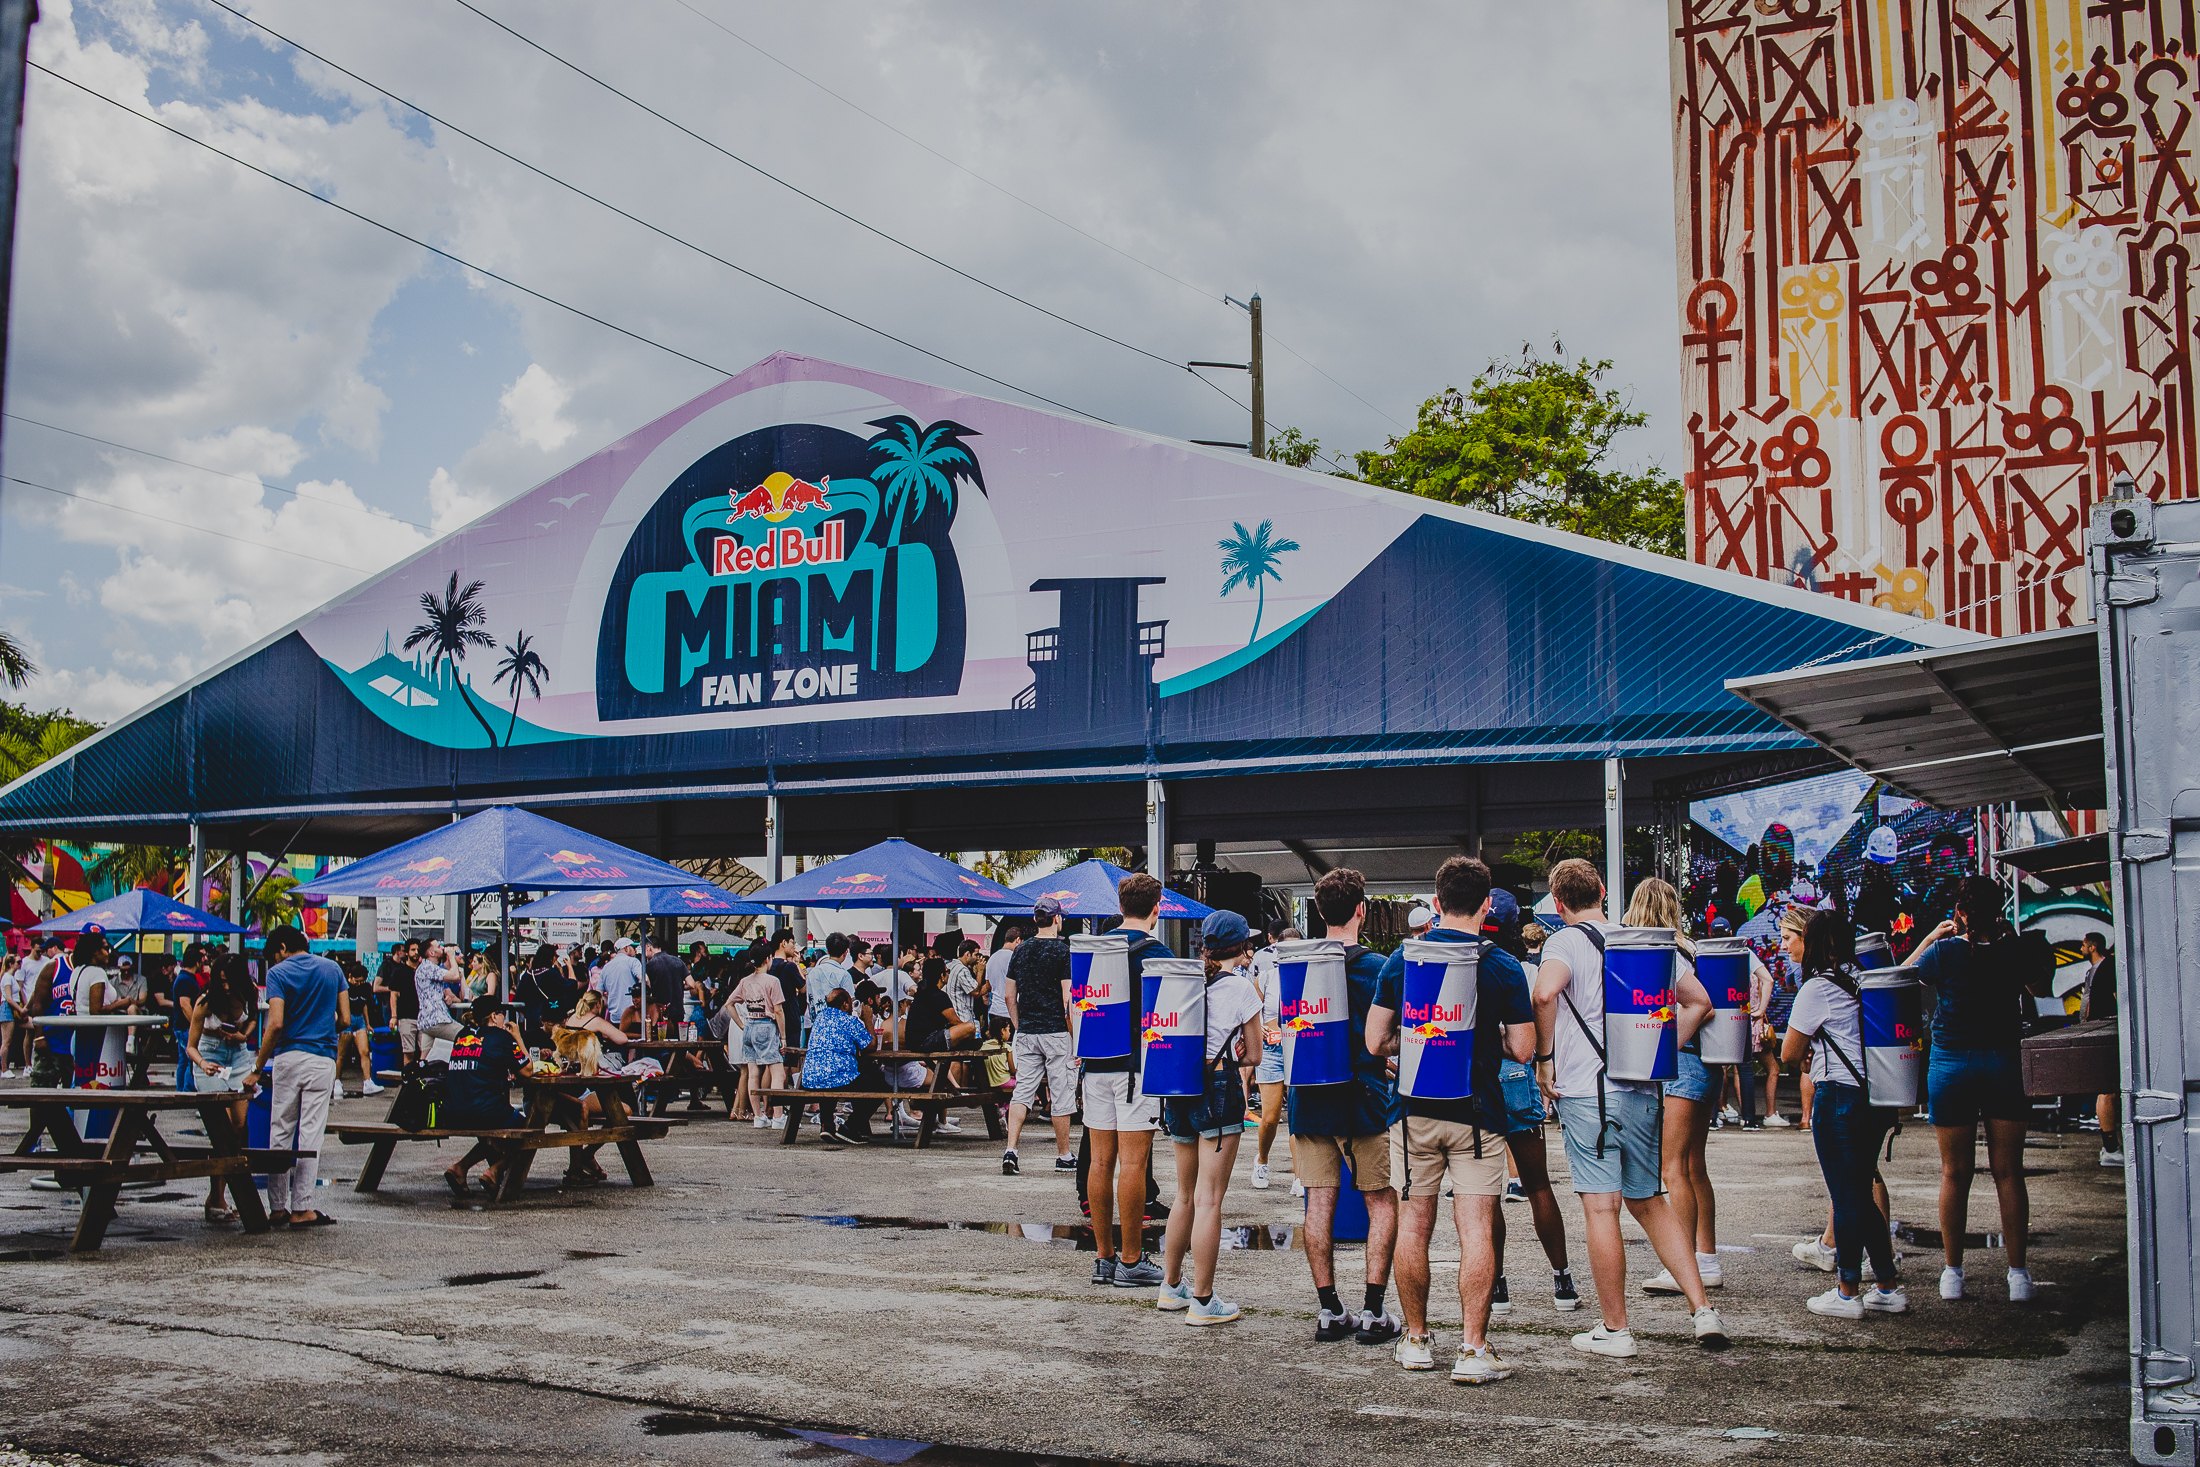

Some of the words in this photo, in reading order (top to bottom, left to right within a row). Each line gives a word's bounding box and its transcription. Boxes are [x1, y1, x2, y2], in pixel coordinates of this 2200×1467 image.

[713, 528, 776, 577] Red
[779, 520, 845, 569] Bull
[663, 545, 897, 690] MIAMI
[702, 673, 762, 706] FAN
[771, 664, 858, 701] ZONE
[817, 885, 853, 895] Red
[852, 884, 887, 894] Bull
[1085, 984, 1109, 998] Bull
[1633, 989, 1664, 1005] Red
[1299, 998, 1328, 1015] Bull
[1405, 1002, 1429, 1021] Red
[1431, 1004, 1461, 1022] Bull
[1152, 1012, 1177, 1027] Bull
[1404, 1037, 1429, 1045] ENERGY
[463, 1047, 483, 1057] Bull
[97, 1061, 123, 1077] Bull
